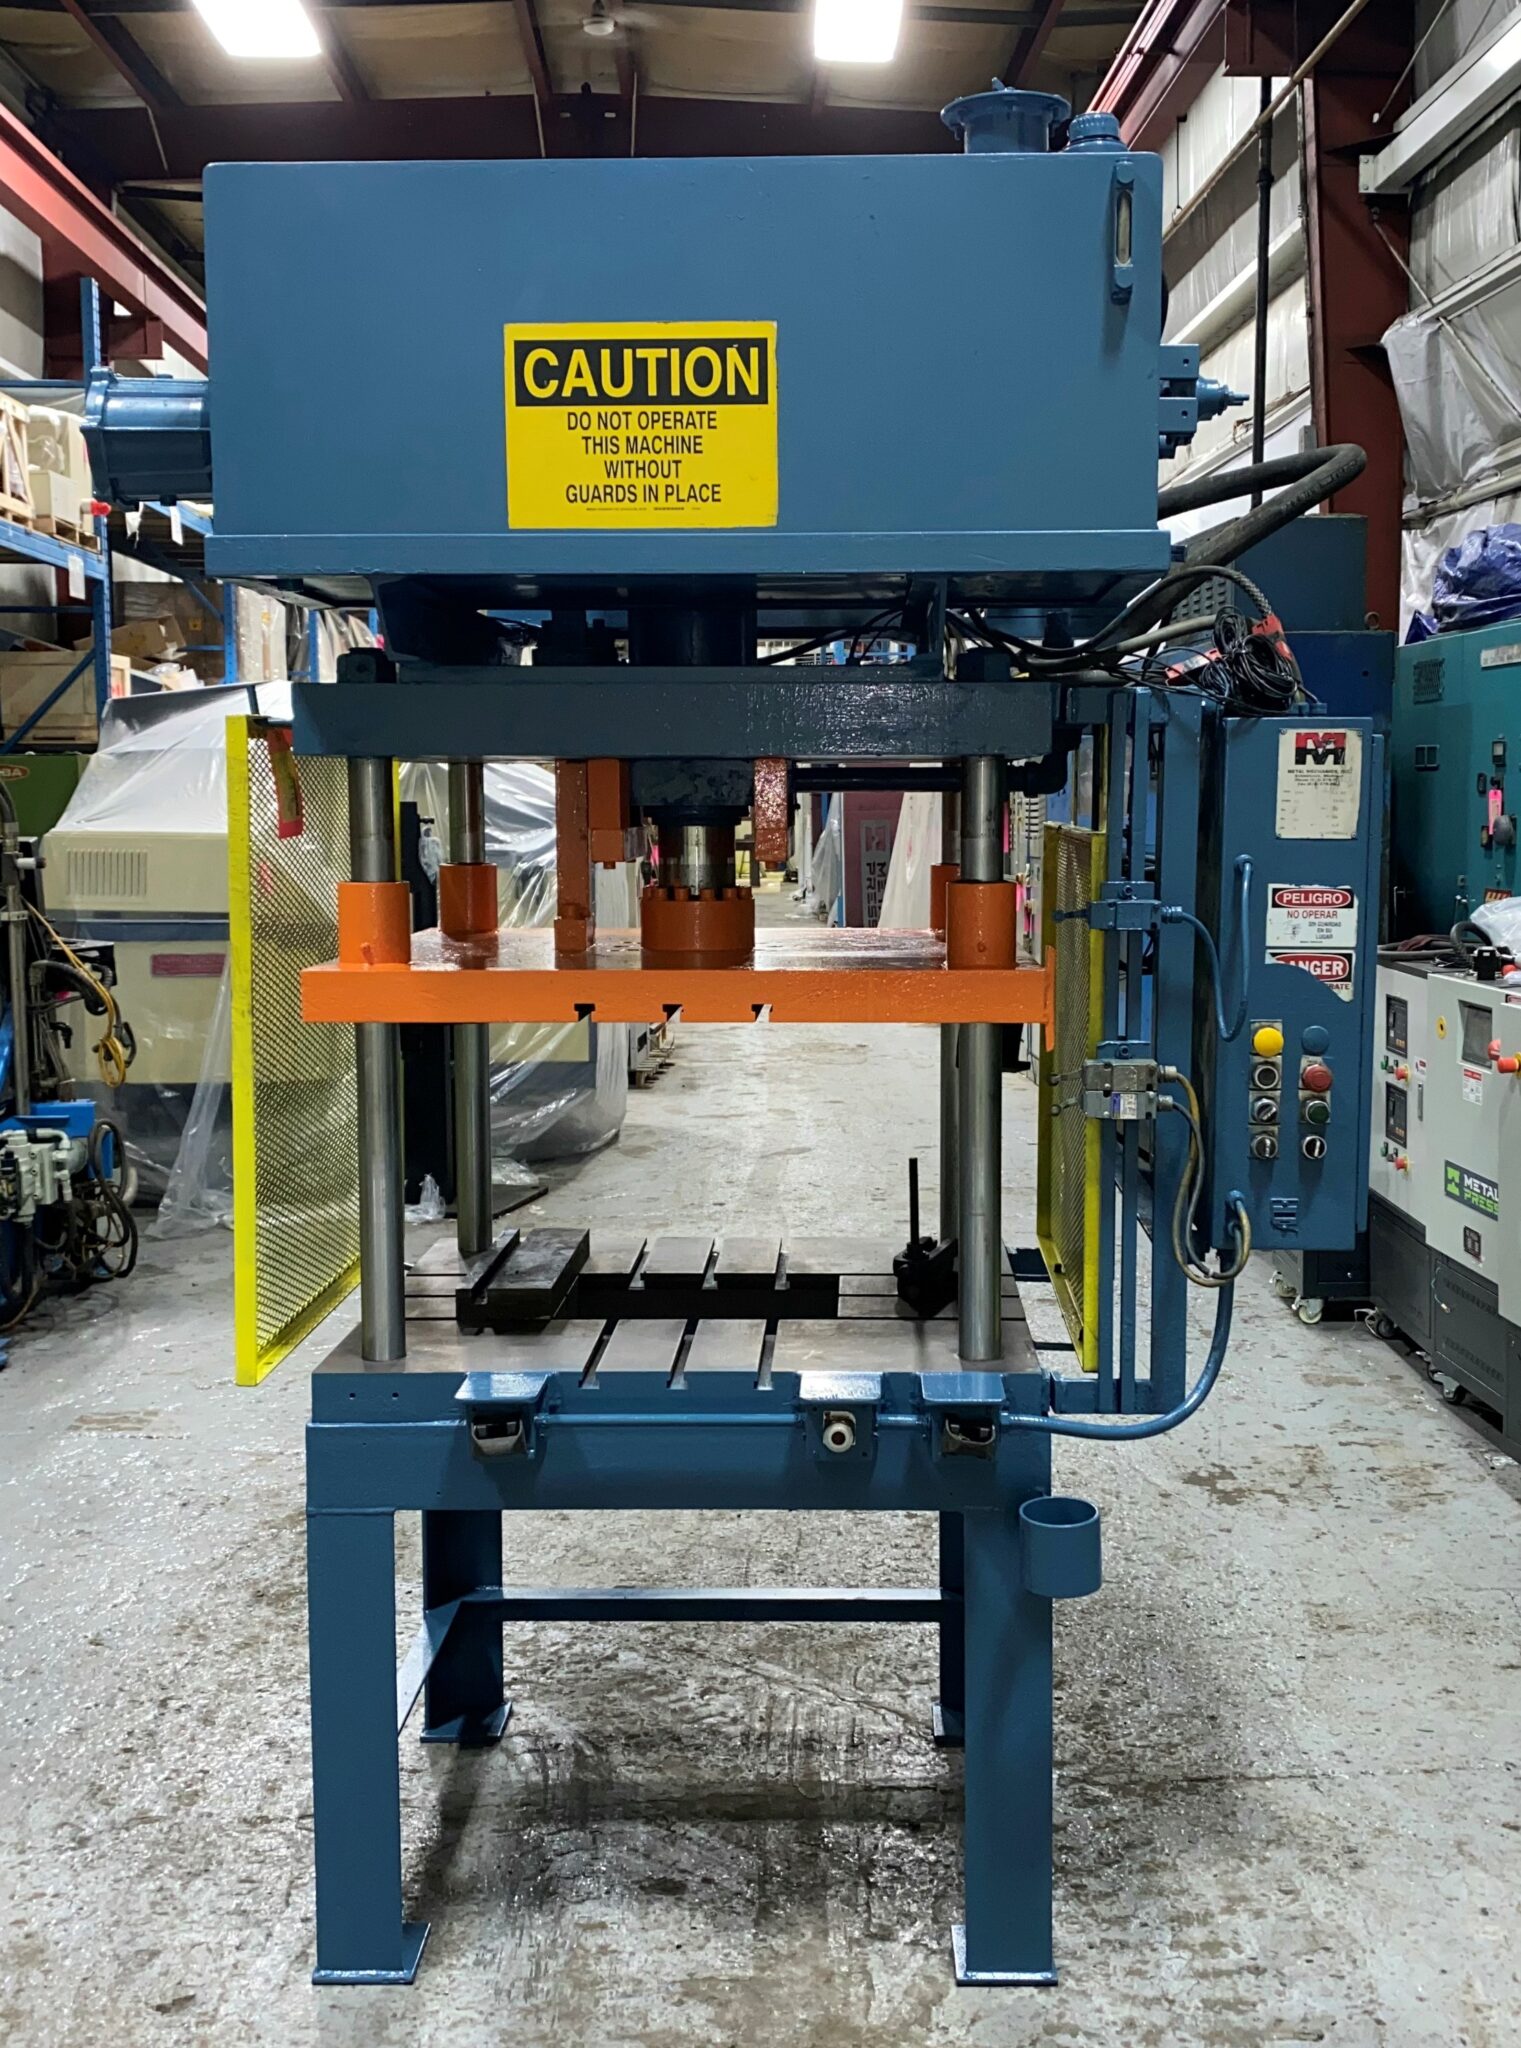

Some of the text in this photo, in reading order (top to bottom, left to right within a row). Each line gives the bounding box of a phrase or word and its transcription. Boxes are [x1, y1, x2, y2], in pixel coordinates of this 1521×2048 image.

[523, 346, 759, 399] CAUTION
[567, 410, 718, 431] DO NOT OPERATE
[581, 435, 704, 455] THIS MACHINE
[604, 459, 682, 479] WITHOUT
[565, 483, 722, 504] GUARDS IN PLACE
[1282, 892, 1343, 904] PELIGRO
[1287, 910, 1338, 919] NO OPERAR
[1463, 1173, 1499, 1202] METAL
